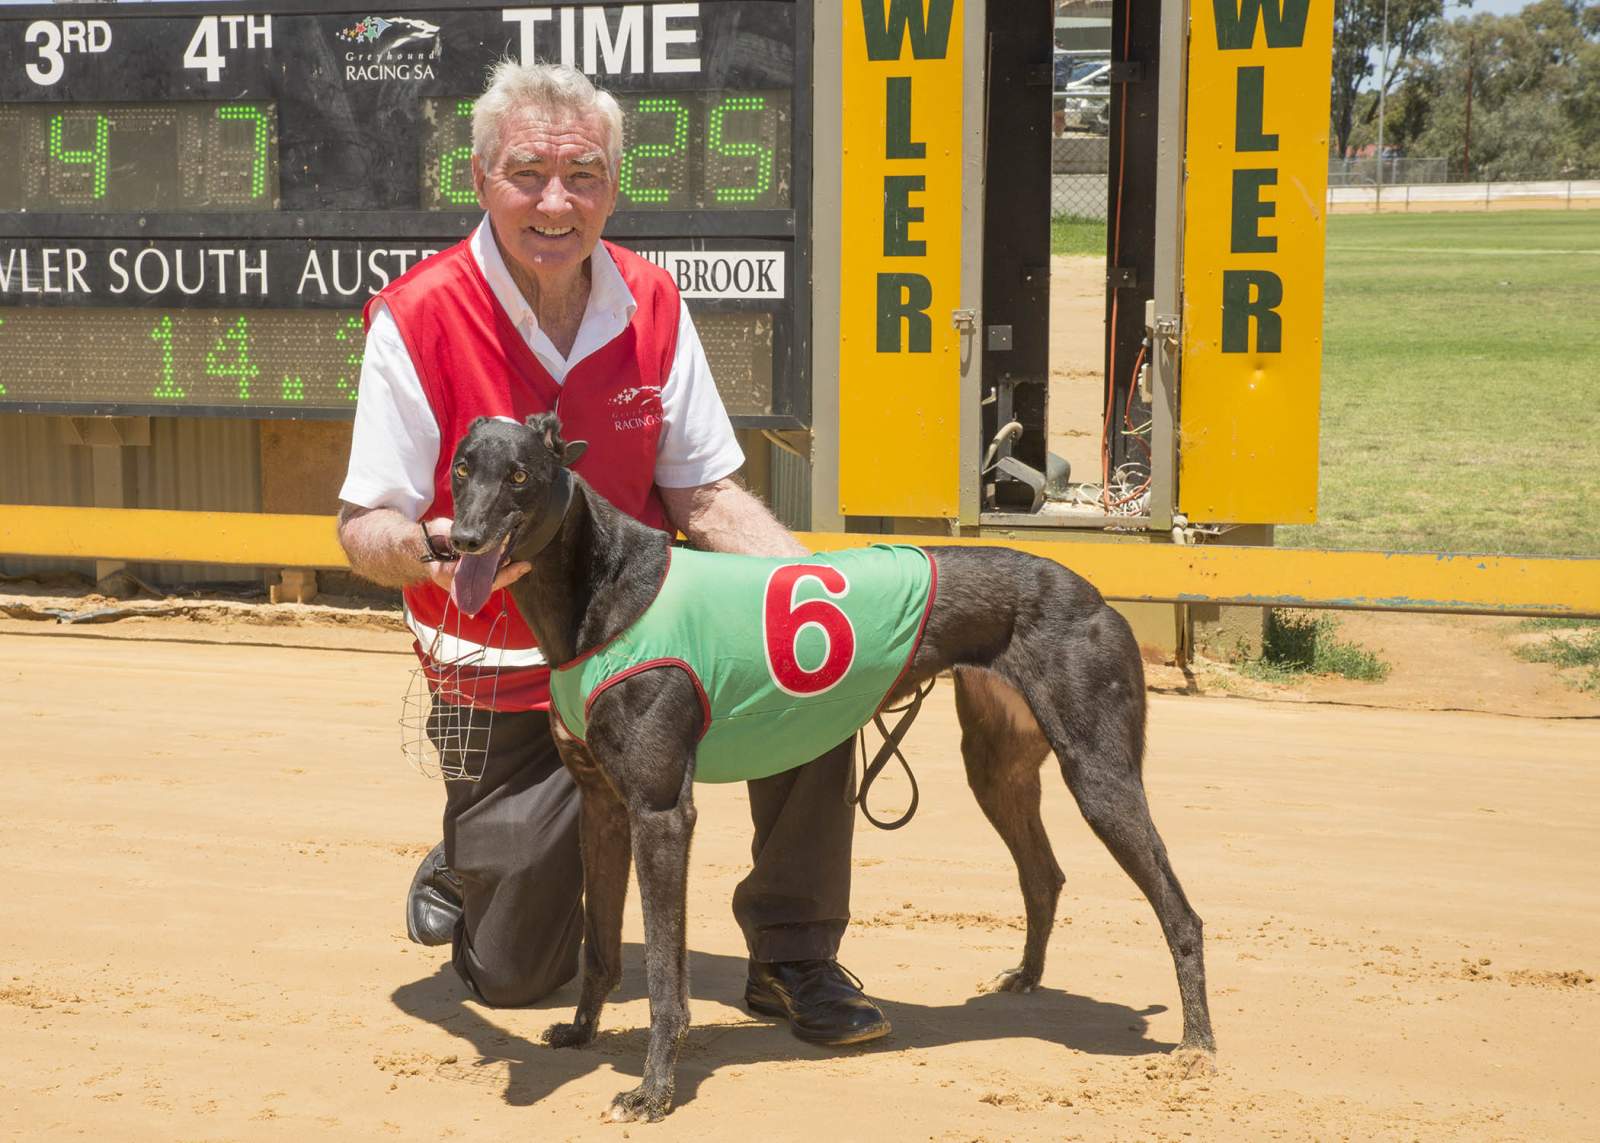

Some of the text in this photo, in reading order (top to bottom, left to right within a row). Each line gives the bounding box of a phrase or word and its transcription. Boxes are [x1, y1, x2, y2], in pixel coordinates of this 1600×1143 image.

[25, 20, 112, 85] 3RD
[183, 14, 273, 82] 4TH
[345, 51, 435, 64] Greyhound
[502, 3, 701, 75] TIME
[346, 65, 435, 80] RACING SA
[50, 115, 108, 199] 4
[216, 106, 268, 199] 7
[109, 248, 268, 294] SOUTH
[297, 249, 439, 295] AUST
[675, 258, 777, 292] BROOK
[762, 563, 856, 697] 6
